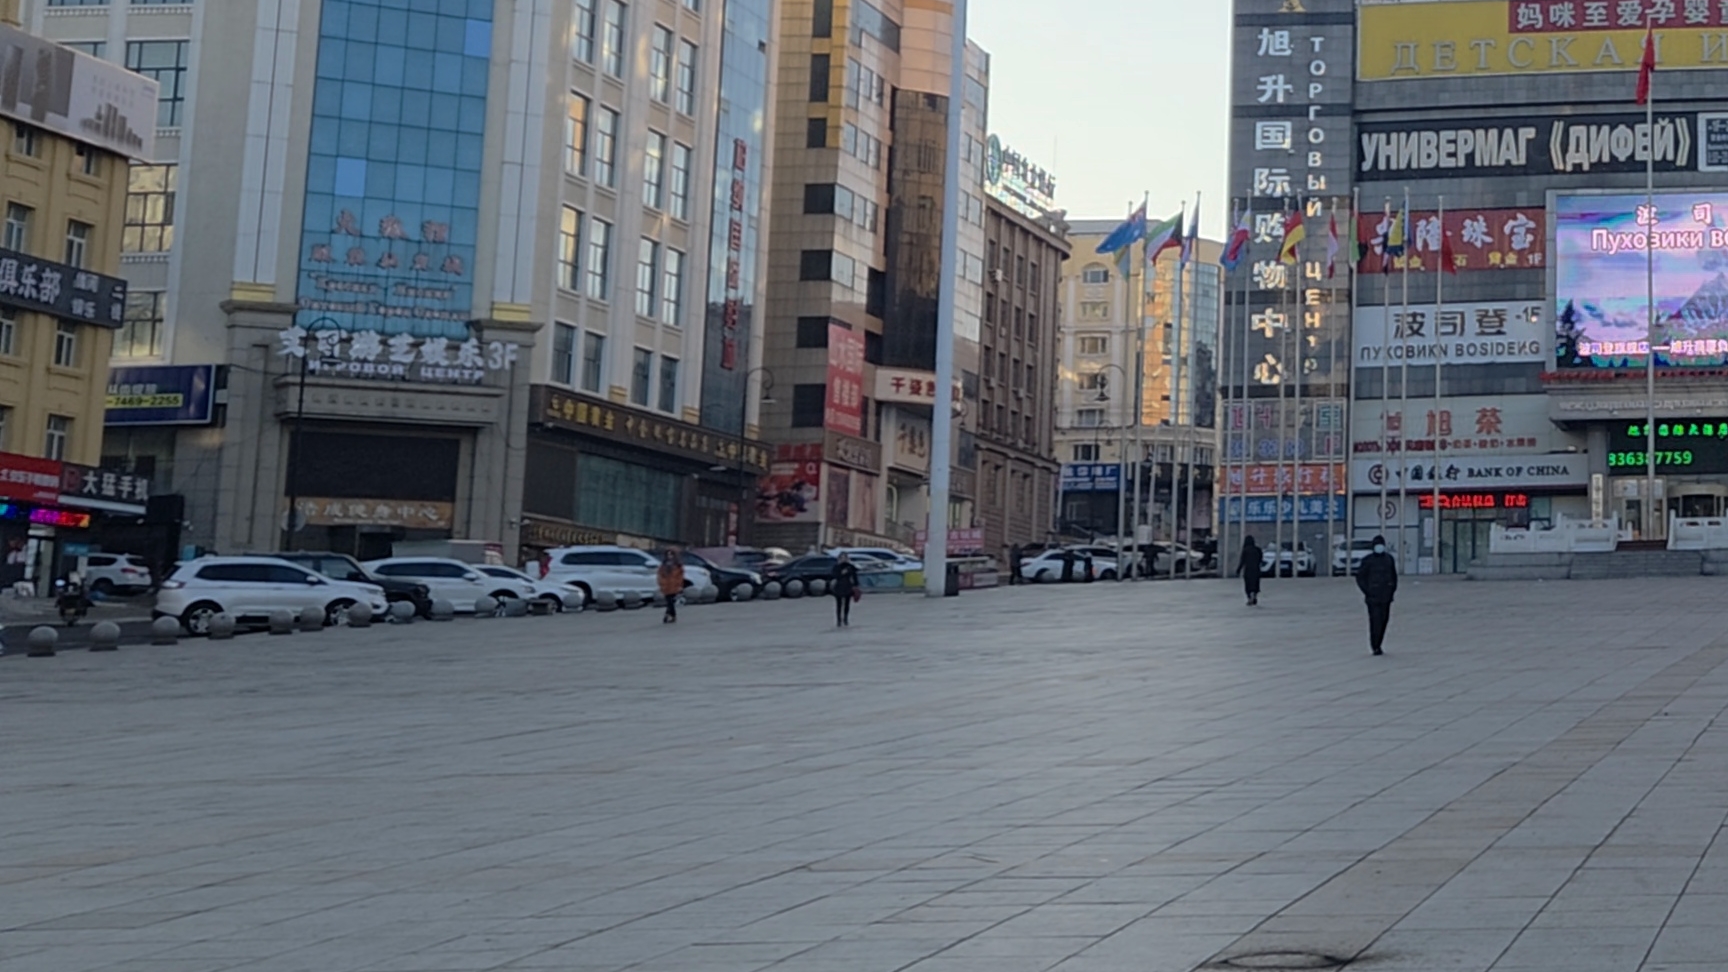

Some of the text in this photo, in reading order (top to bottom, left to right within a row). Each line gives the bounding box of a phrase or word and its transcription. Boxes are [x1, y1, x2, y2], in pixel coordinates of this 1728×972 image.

[1306, 37, 1327, 217] ТОРГОВЫЙ
[1360, 127, 1536, 172] УНИВЕРМАГ
[1251, 28, 1293, 385] 旭升国际购物中心
[1591, 229, 1704, 256] Пуховики
[1393, 308, 1508, 339] 波司登
[1467, 467, 1503, 479] BANK
[1506, 466, 1523, 477] OF
[1527, 465, 1570, 477] CHINA
